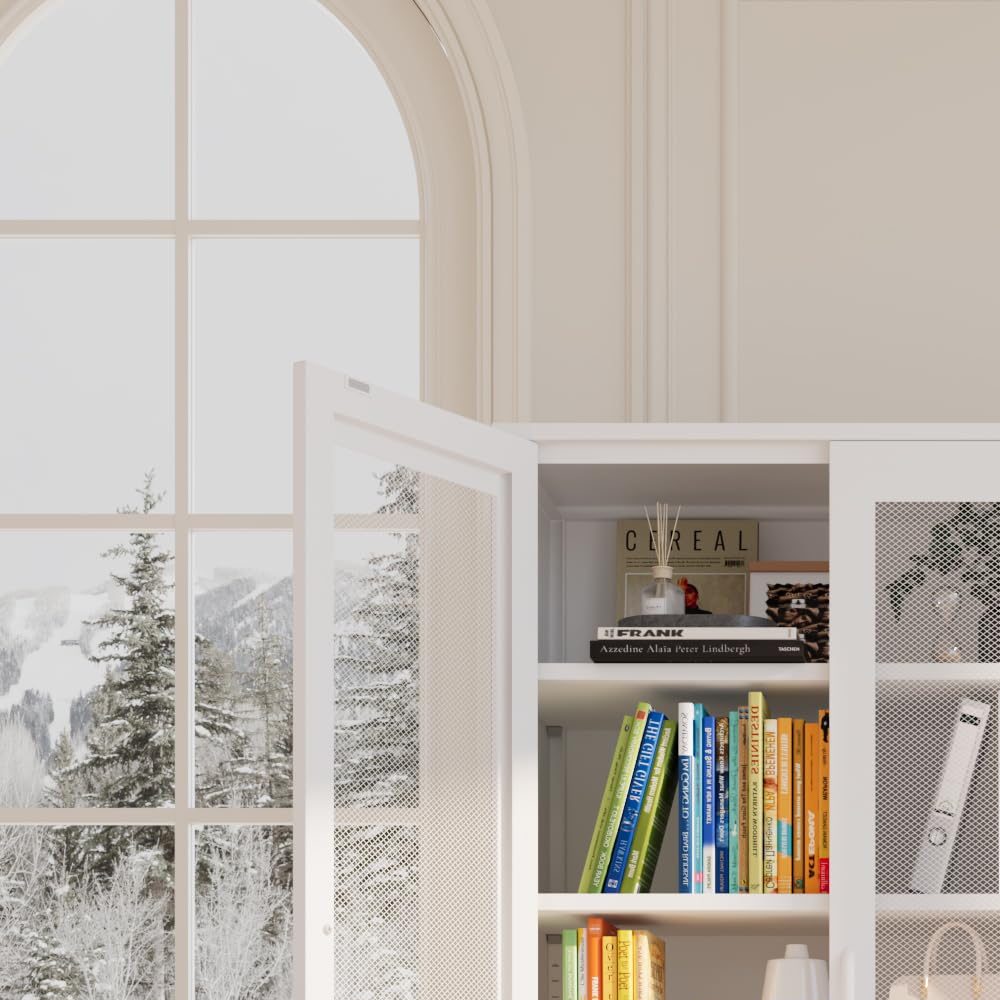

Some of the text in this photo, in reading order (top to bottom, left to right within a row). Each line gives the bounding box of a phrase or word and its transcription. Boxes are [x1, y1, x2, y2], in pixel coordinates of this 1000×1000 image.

[626, 530, 748, 551] CEREAL
[617, 629, 684, 637] FRANK
[600, 644, 643, 653] Azzedine
[675, 645, 698, 653] Peter
[702, 644, 751, 655] Lindbergh
